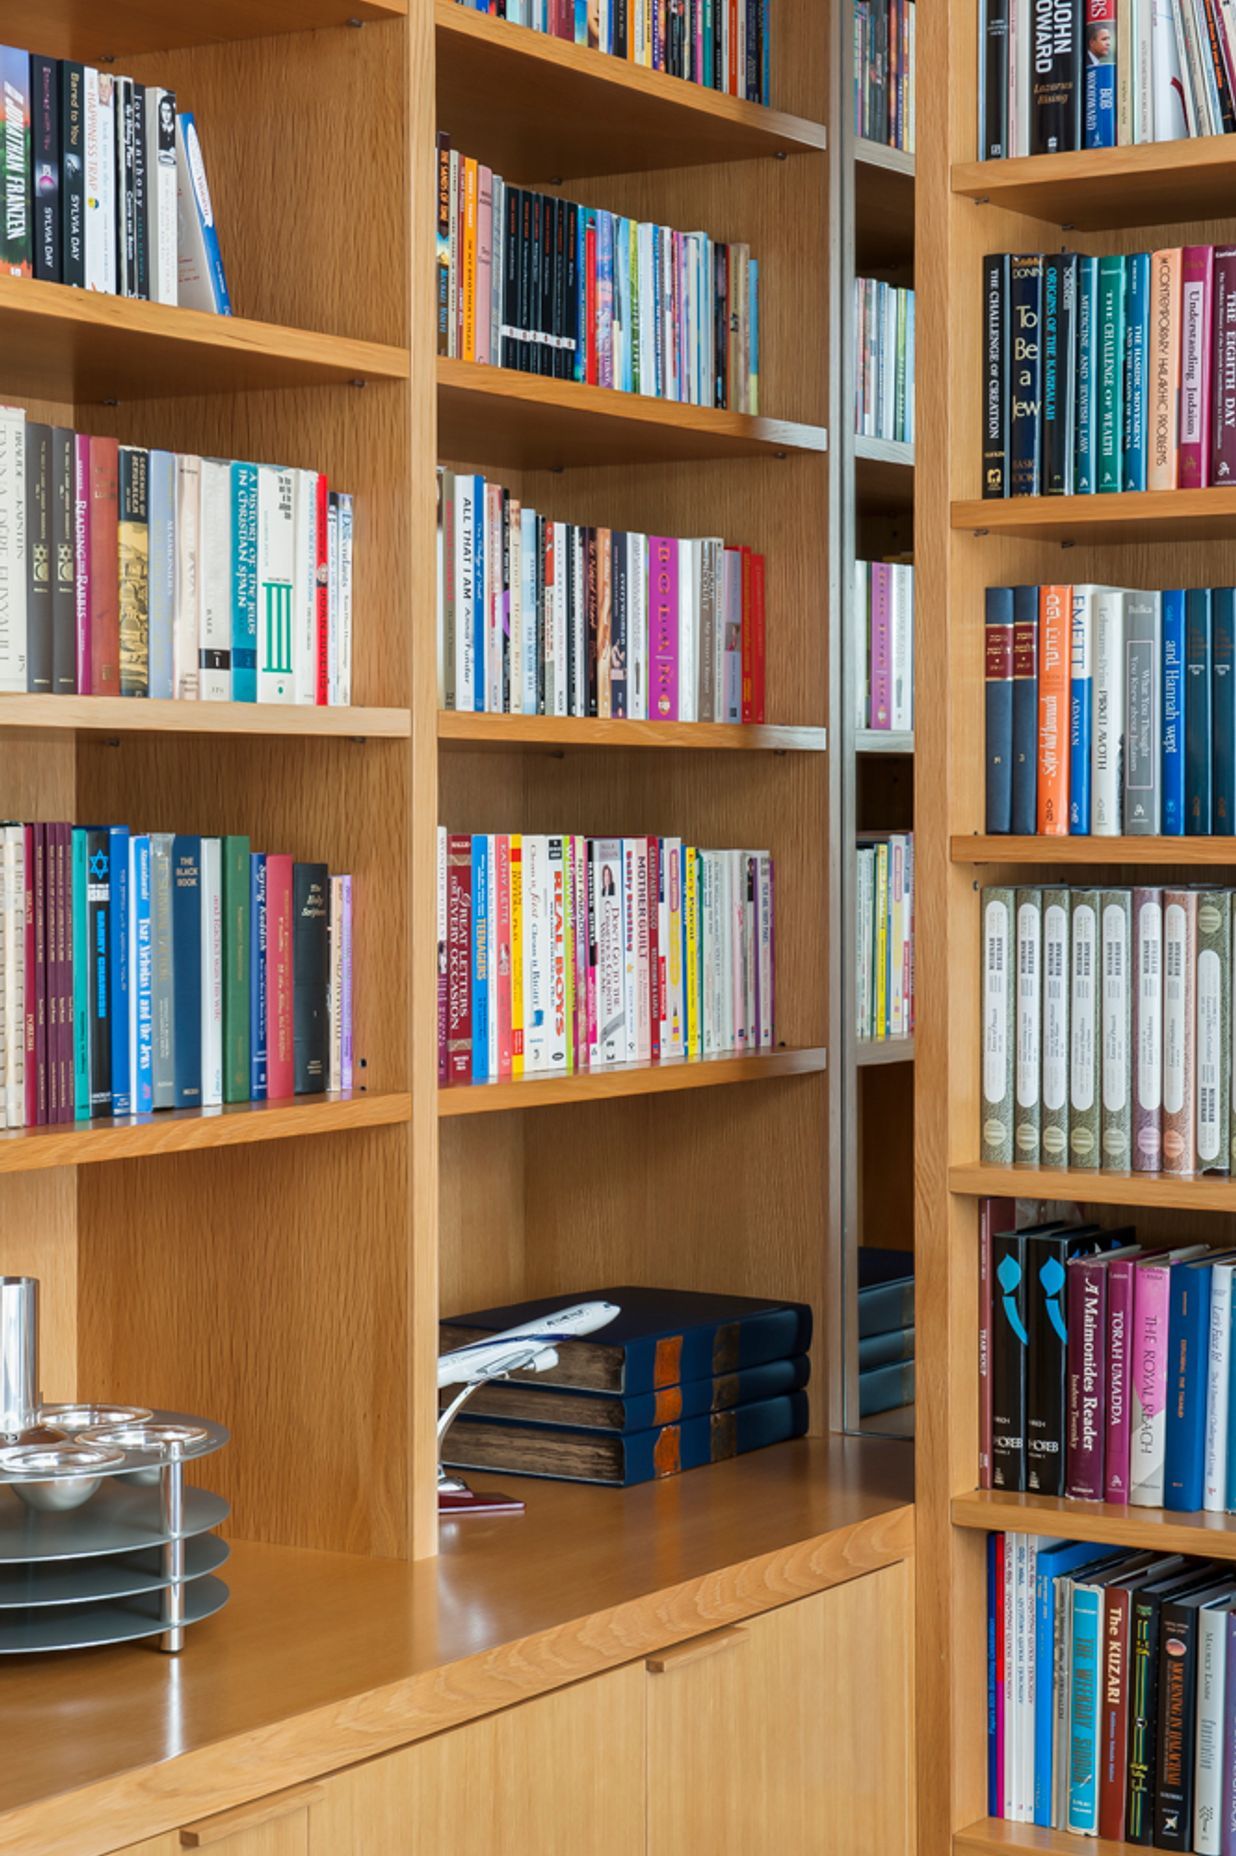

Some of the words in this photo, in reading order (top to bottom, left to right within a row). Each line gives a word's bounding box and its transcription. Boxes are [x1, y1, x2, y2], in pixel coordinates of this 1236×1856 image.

[1036, 0, 1053, 74] OWARD
[1100, 87, 1113, 111] BOB
[6, 175, 25, 239] FRANZEN
[44, 245, 54, 267] DAY
[70, 236, 80, 261] DAY
[990, 268, 1000, 289] THE
[989, 290, 1000, 361] CHALLENGE
[1014, 336, 1040, 361] Be
[1184, 290, 1201, 381] Understanding
[1079, 353, 1090, 380] AND
[1103, 322, 1116, 387] CHALLENGE
[989, 379, 1000, 440] CREATION
[1103, 411, 1116, 457] WEALTH
[1185, 386, 1199, 436] Judaism
[1224, 397, 1236, 428] DAY
[1079, 429, 1089, 455] LAW
[462, 497, 472, 524] ALL
[462, 530, 472, 564] THAT
[463, 577, 472, 600] AM
[1164, 640, 1181, 666] and
[1164, 669, 1181, 721] Hannah
[1162, 724, 1179, 754] wept
[553, 870, 563, 948] REAL
[449, 947, 459, 1030] OCCASION
[459, 950, 469, 1017] LETTERS
[555, 955, 564, 1037] BOYS
[1082, 1296, 1099, 1392] Maimonides
[1111, 1310, 1125, 1360] TORAH
[1144, 1314, 1158, 1344] THE
[1110, 1361, 1124, 1426] UMADDA
[1142, 1349, 1157, 1397] ROYAL
[1080, 1396, 1099, 1452] Reader
[1140, 1403, 1155, 1455] REACH
[1107, 1606, 1123, 1636] The
[1106, 1640, 1123, 1705] KUZARI
